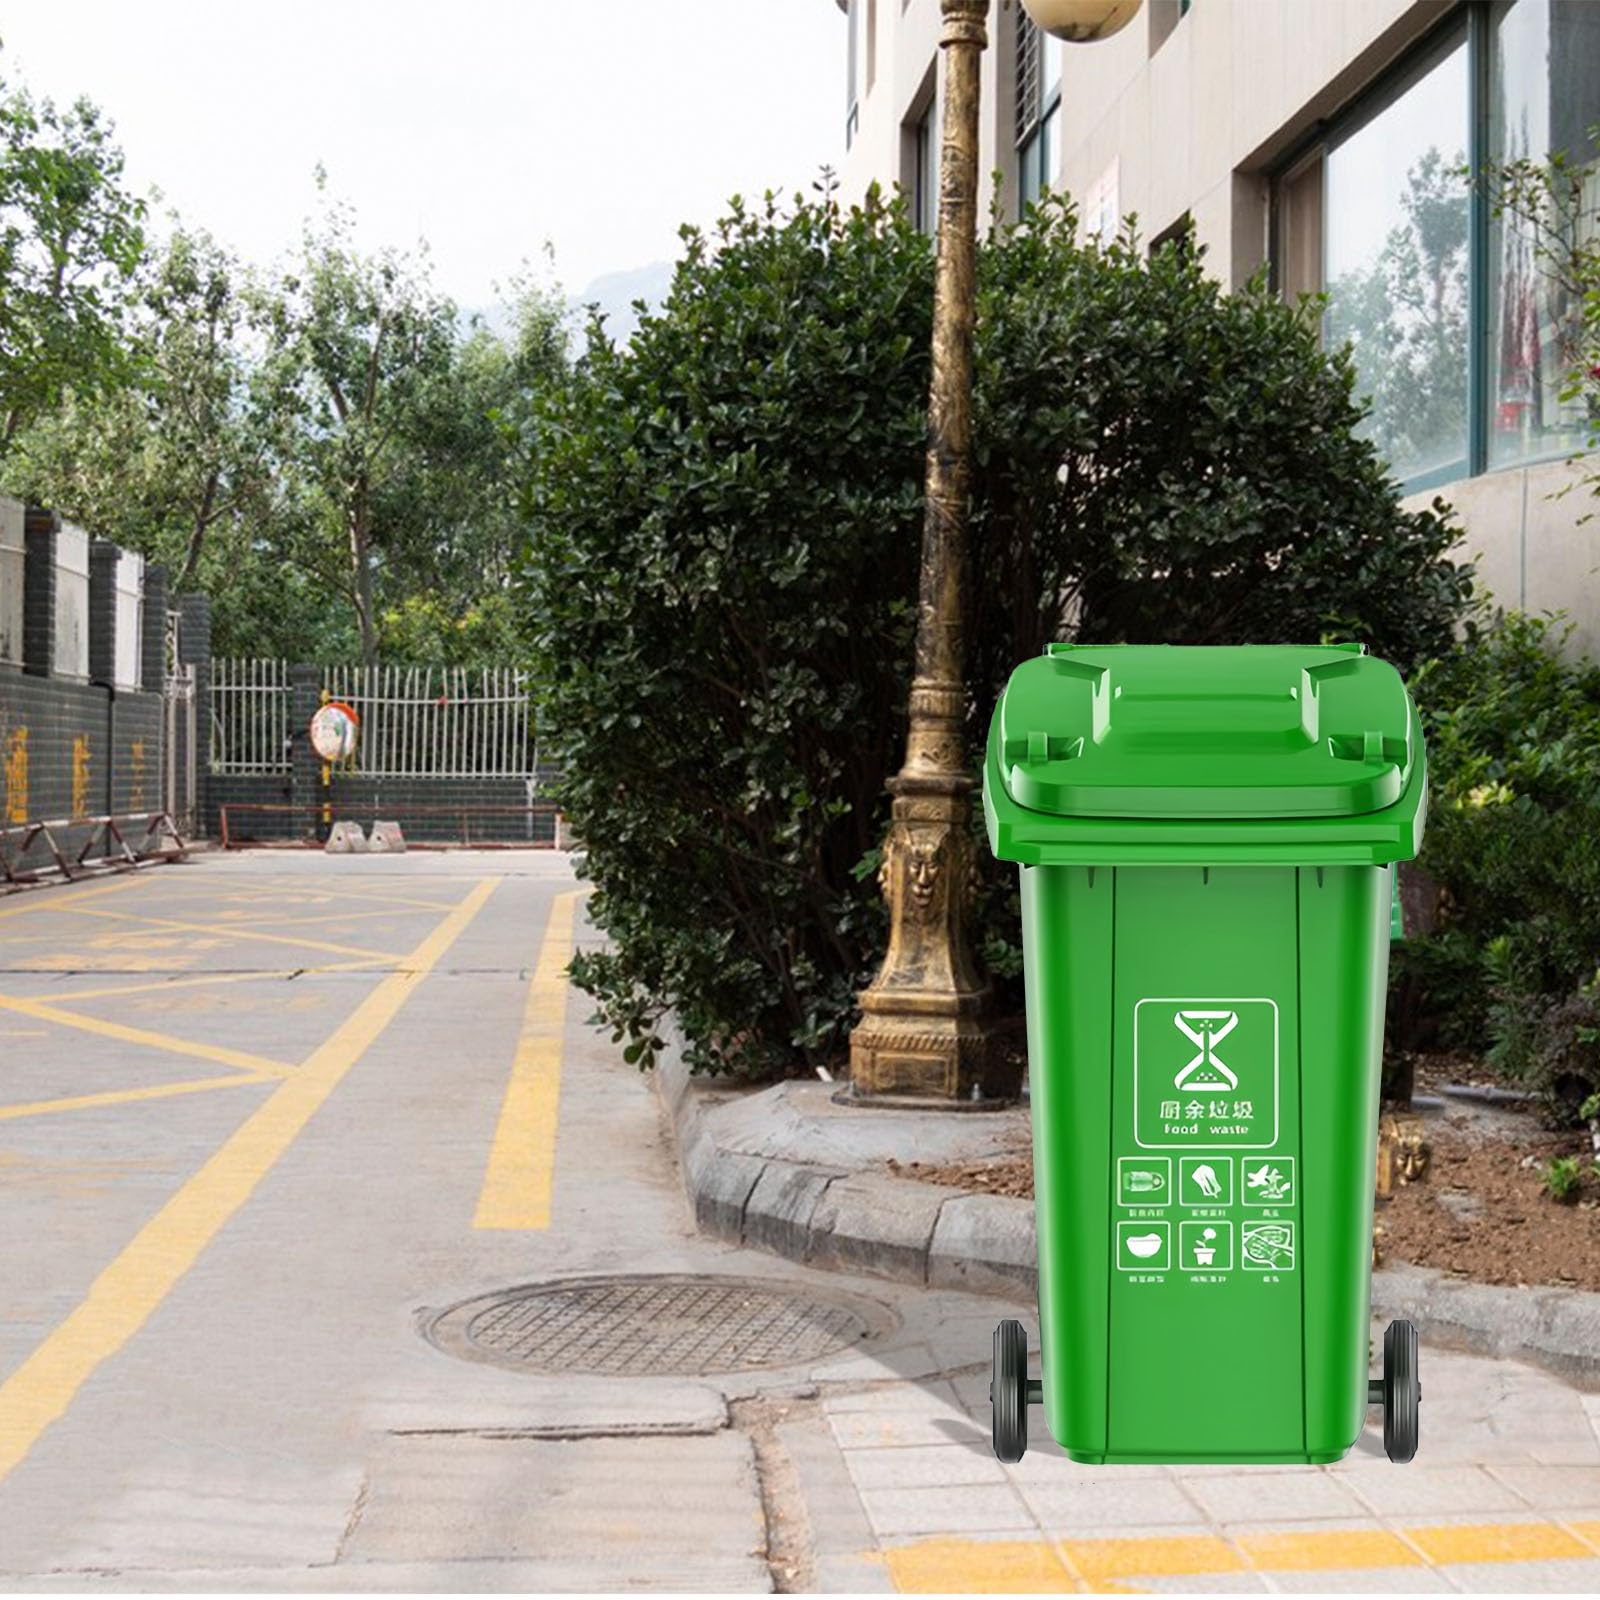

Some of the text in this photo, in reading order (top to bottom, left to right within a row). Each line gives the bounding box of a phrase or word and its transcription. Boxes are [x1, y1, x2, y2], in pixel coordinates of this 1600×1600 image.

[1160, 1099, 1254, 1120] 厨余垃圾
[1209, 1125, 1249, 1134] waste
